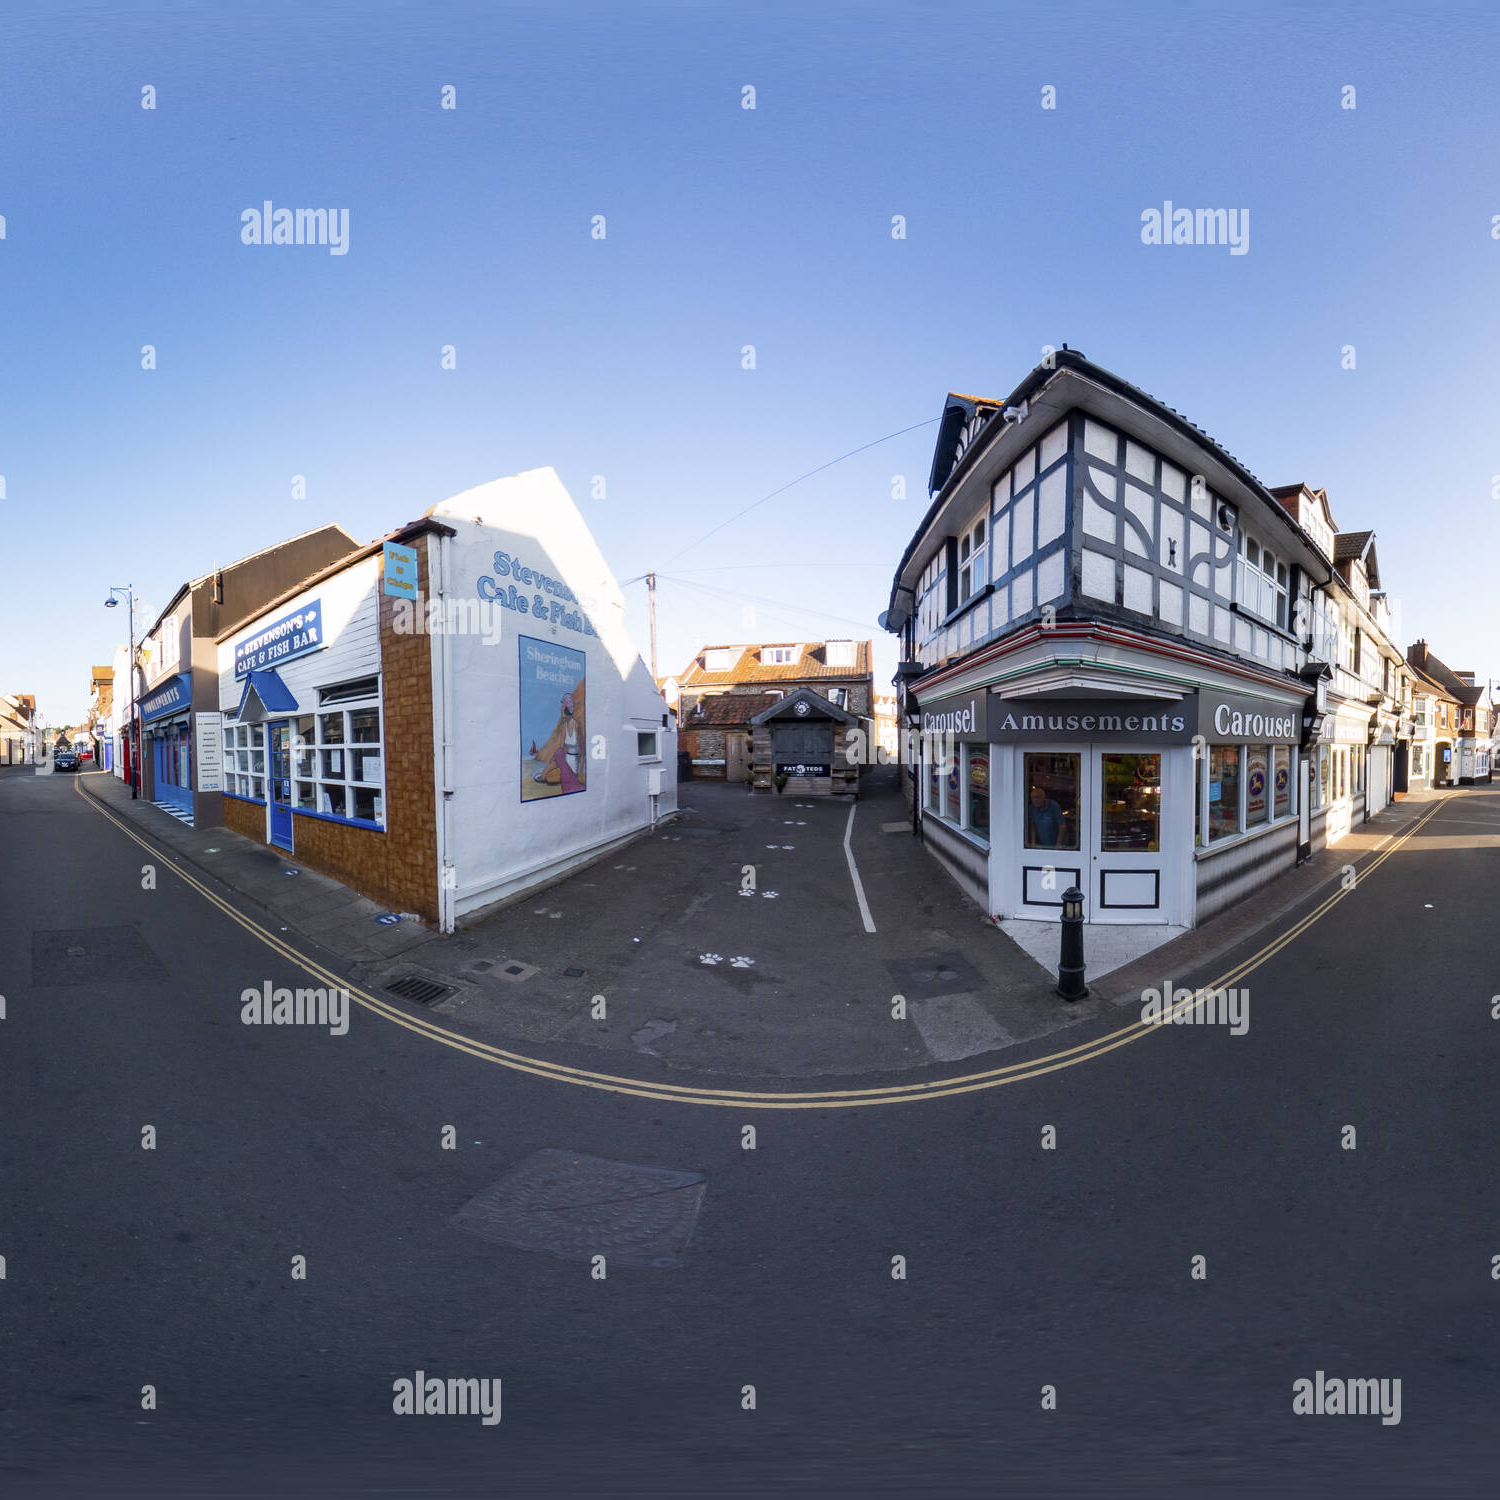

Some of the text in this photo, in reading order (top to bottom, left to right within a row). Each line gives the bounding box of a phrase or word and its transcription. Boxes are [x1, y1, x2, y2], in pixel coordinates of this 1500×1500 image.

[389, 551, 410, 563] Fish
[386, 577, 414, 591] Chips
[476, 575, 529, 614] Cafe
[532, 594, 549, 621] &
[550, 600, 582, 633] Fish
[244, 614, 303, 655] STEVENSON'S
[237, 627, 318, 673] CAFE & FISH BAR
[526, 646, 581, 672] Sheringham
[535, 665, 574, 685] Beaches
[924, 700, 977, 734] Carousel
[1000, 712, 1186, 732] Amusements
[1214, 703, 1296, 738] Carousel
